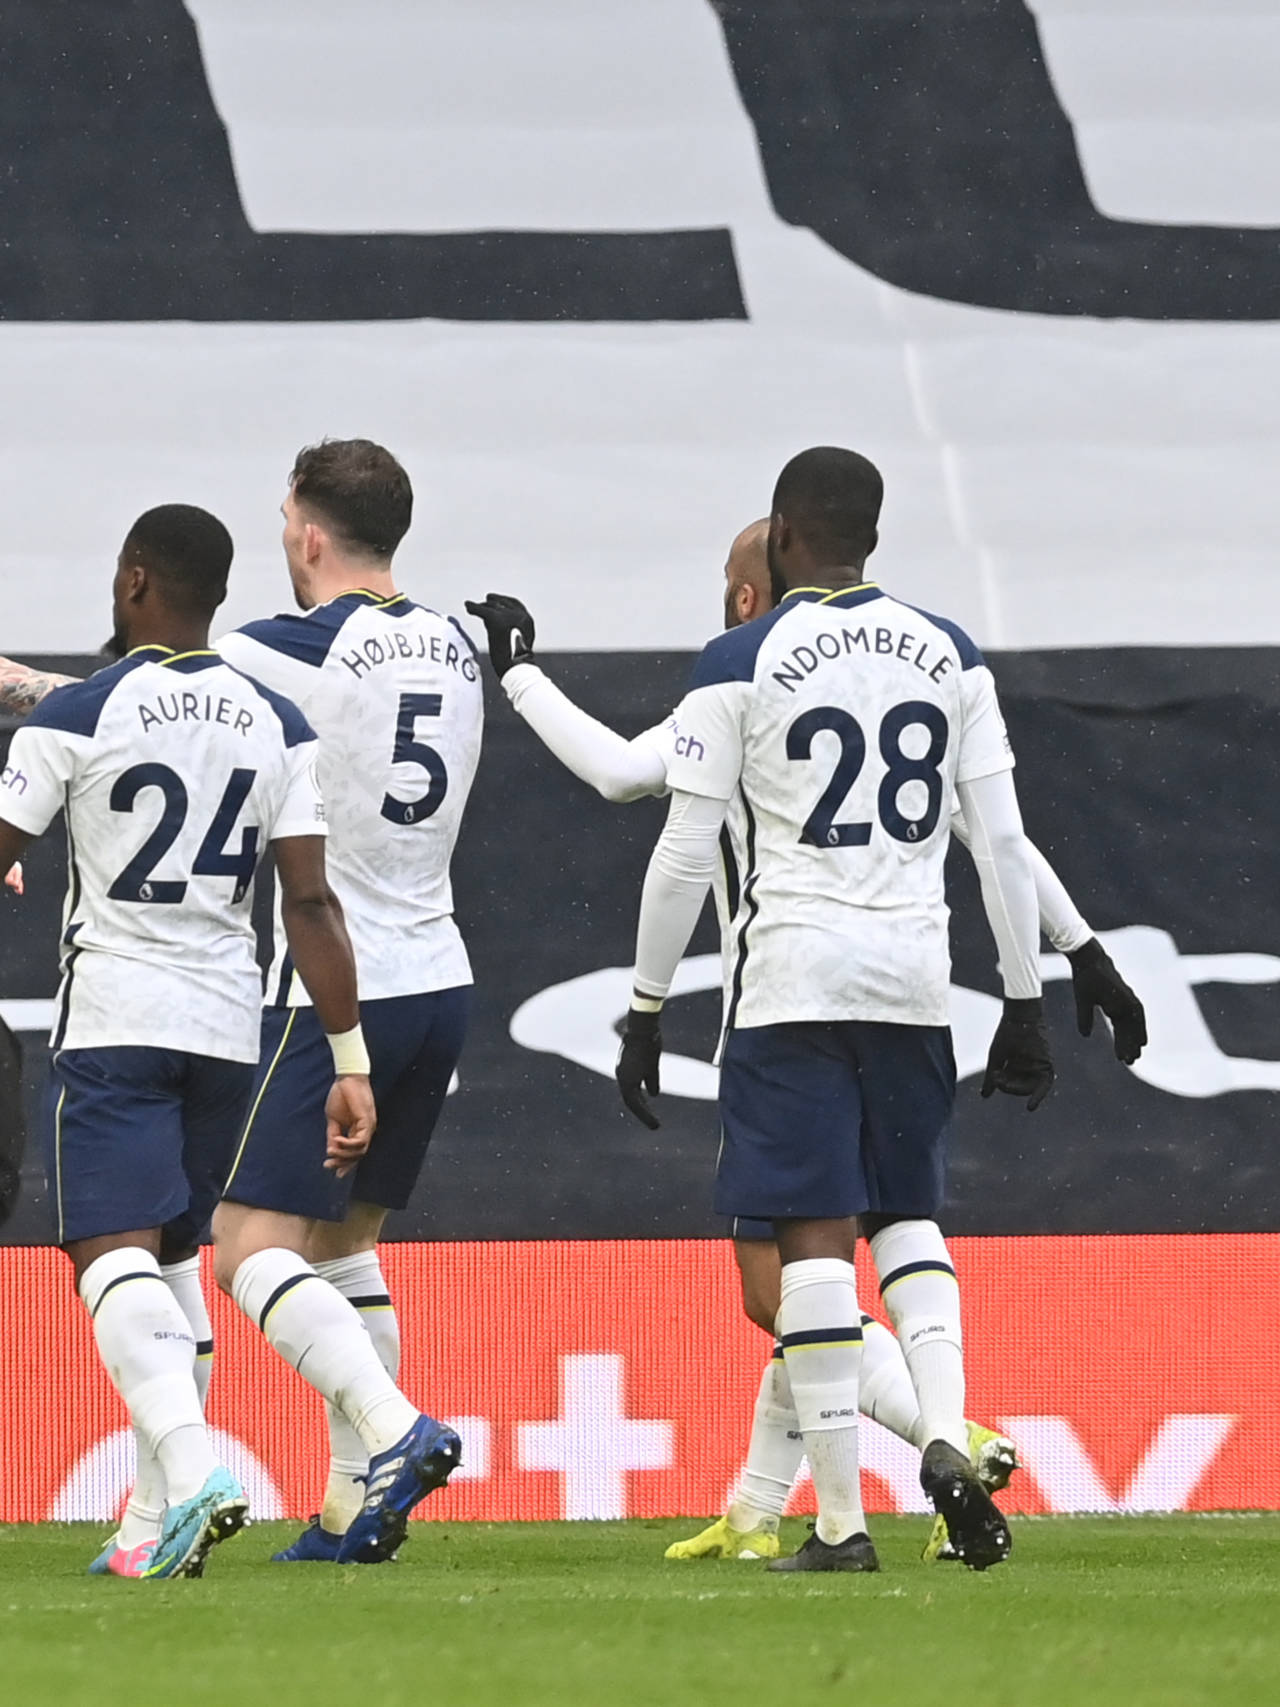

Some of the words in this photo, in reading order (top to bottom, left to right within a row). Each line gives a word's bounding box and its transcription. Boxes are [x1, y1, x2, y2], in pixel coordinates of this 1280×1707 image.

[340, 632, 477, 683] HØJBJERG
[772, 626, 954, 693] NDOMBELE
[138, 692, 254, 737] AURIER
[380, 692, 448, 826] 5
[785, 700, 949, 848] 28
[106, 762, 260, 905] 24
[820, 1408, 855, 1419] SPURS
